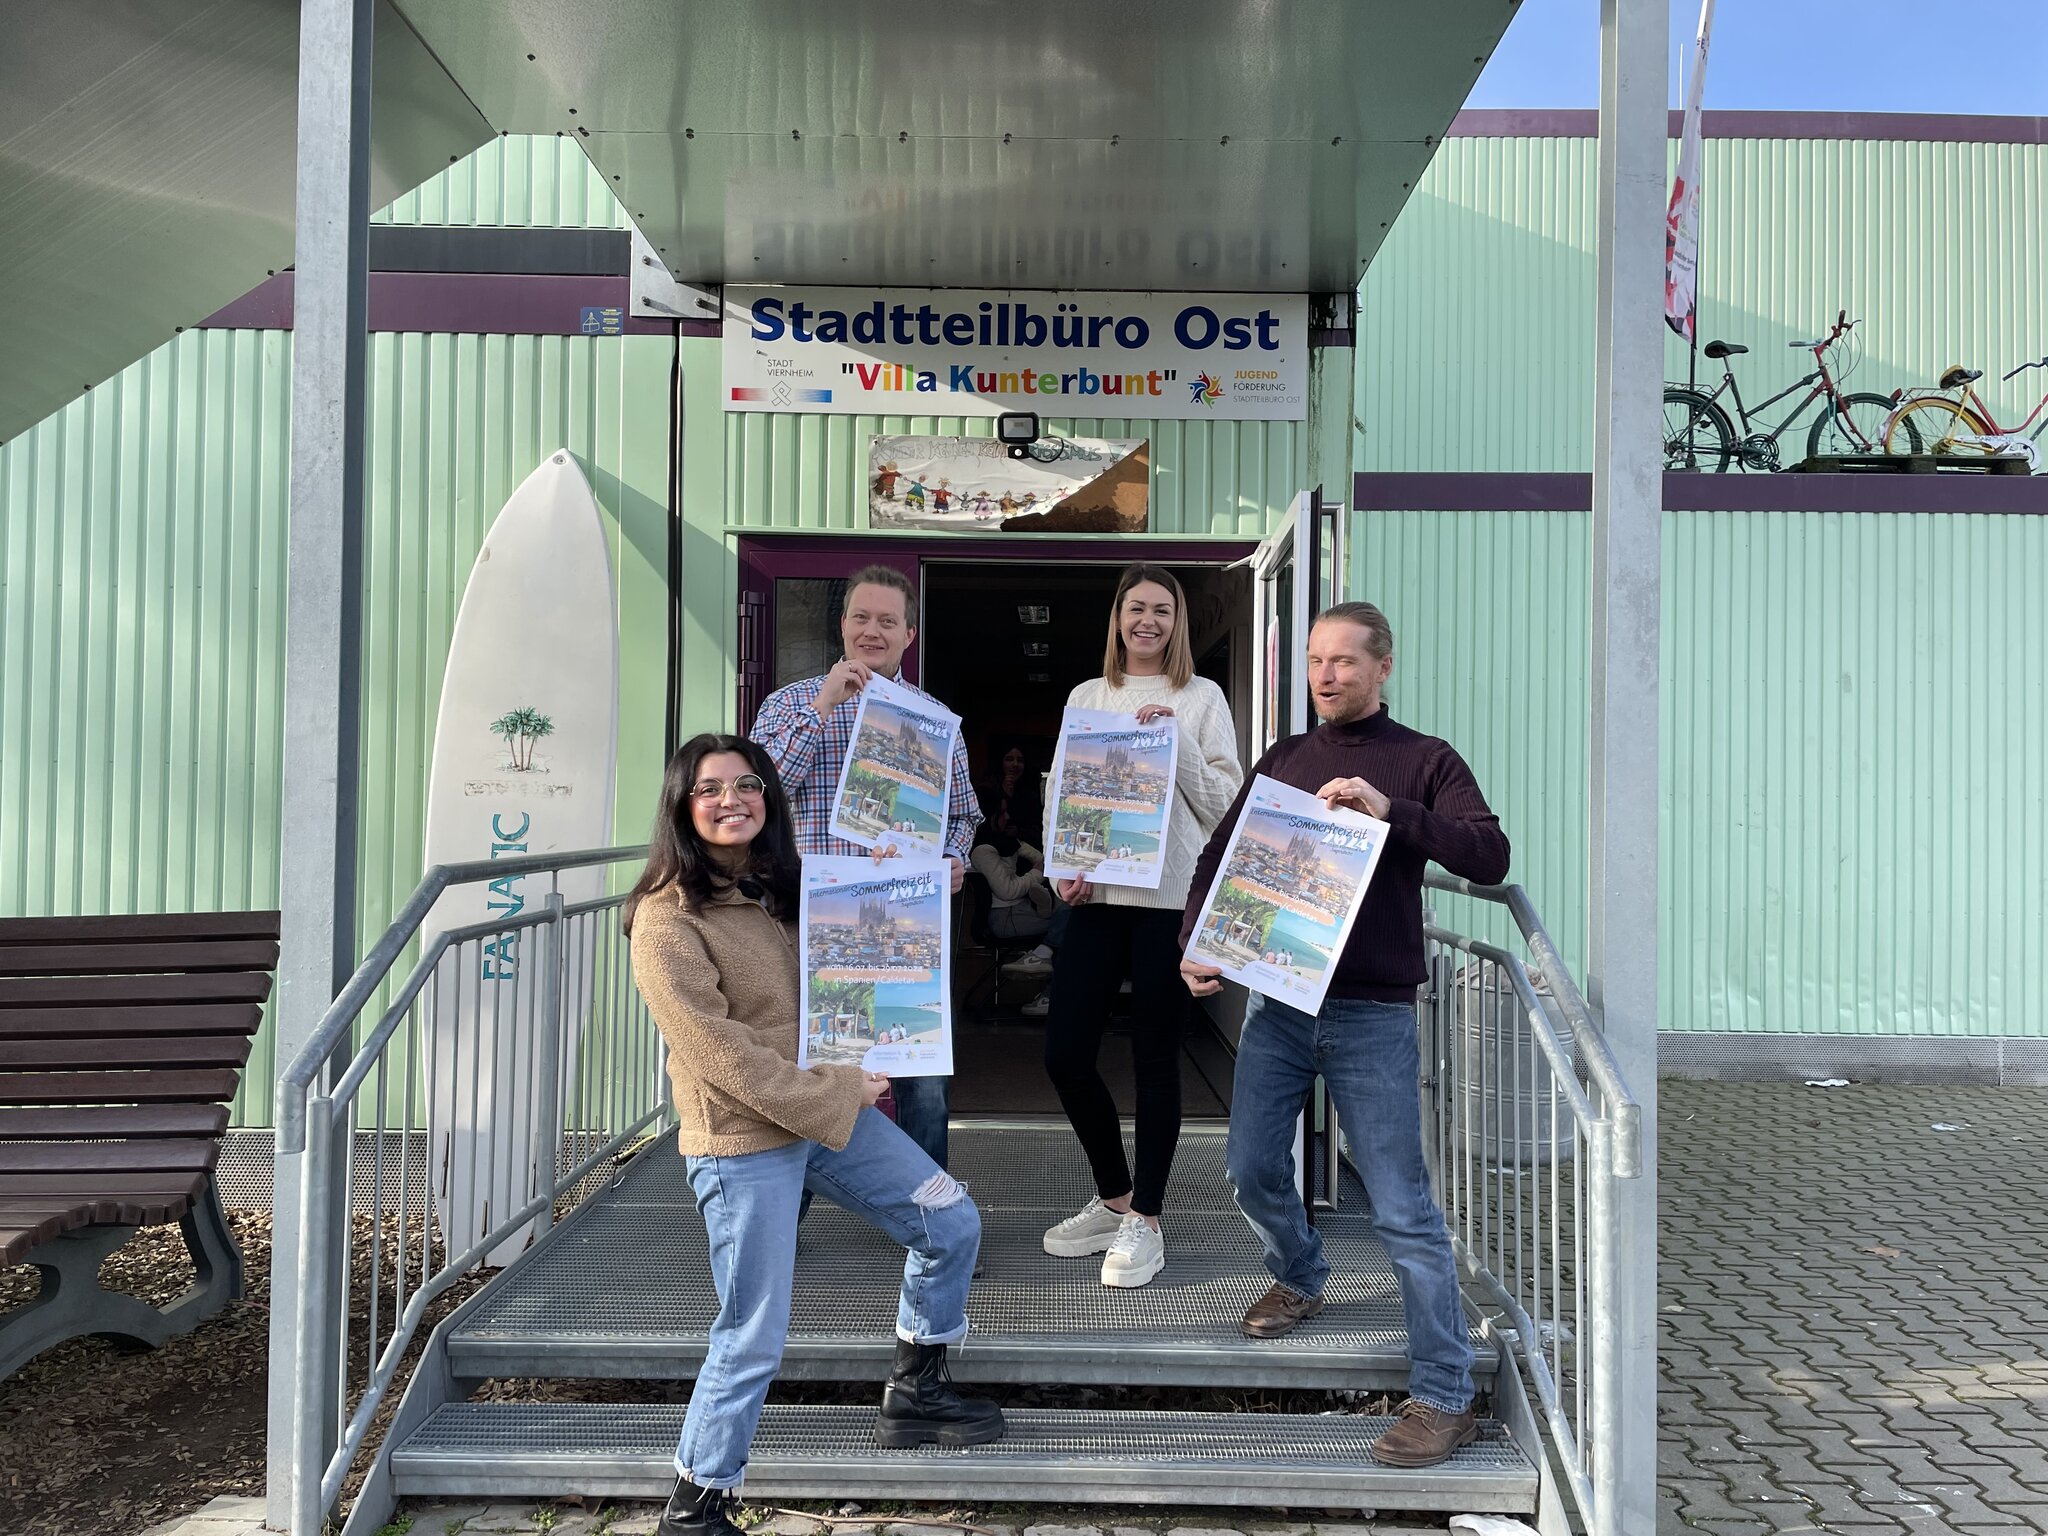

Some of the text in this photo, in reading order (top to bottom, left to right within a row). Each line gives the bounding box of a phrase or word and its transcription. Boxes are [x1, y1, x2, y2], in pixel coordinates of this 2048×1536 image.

[751, 297, 1280, 350] Stadtteilbüro Ost
[767, 359, 794, 368] STADT
[767, 368, 814, 377] VIERNHEIM
[842, 363, 1177, 396] "Villa Kunterbunt"
[1234, 370, 1278, 380] JUGEND
[1286, 396, 1301, 404] OST
[1101, 727, 1167, 743] Sommerfreizeit
[1288, 816, 1367, 840] Sommerfreizeit
[809, 871, 933, 899] Internationale Sommerfreizeit
[888, 883, 938, 901] 2024
[483, 811, 530, 981] FANAIC
[826, 963, 844, 971] vom
[868, 963, 879, 972] bis
[844, 975, 916, 985] Spanien/Caldetas
